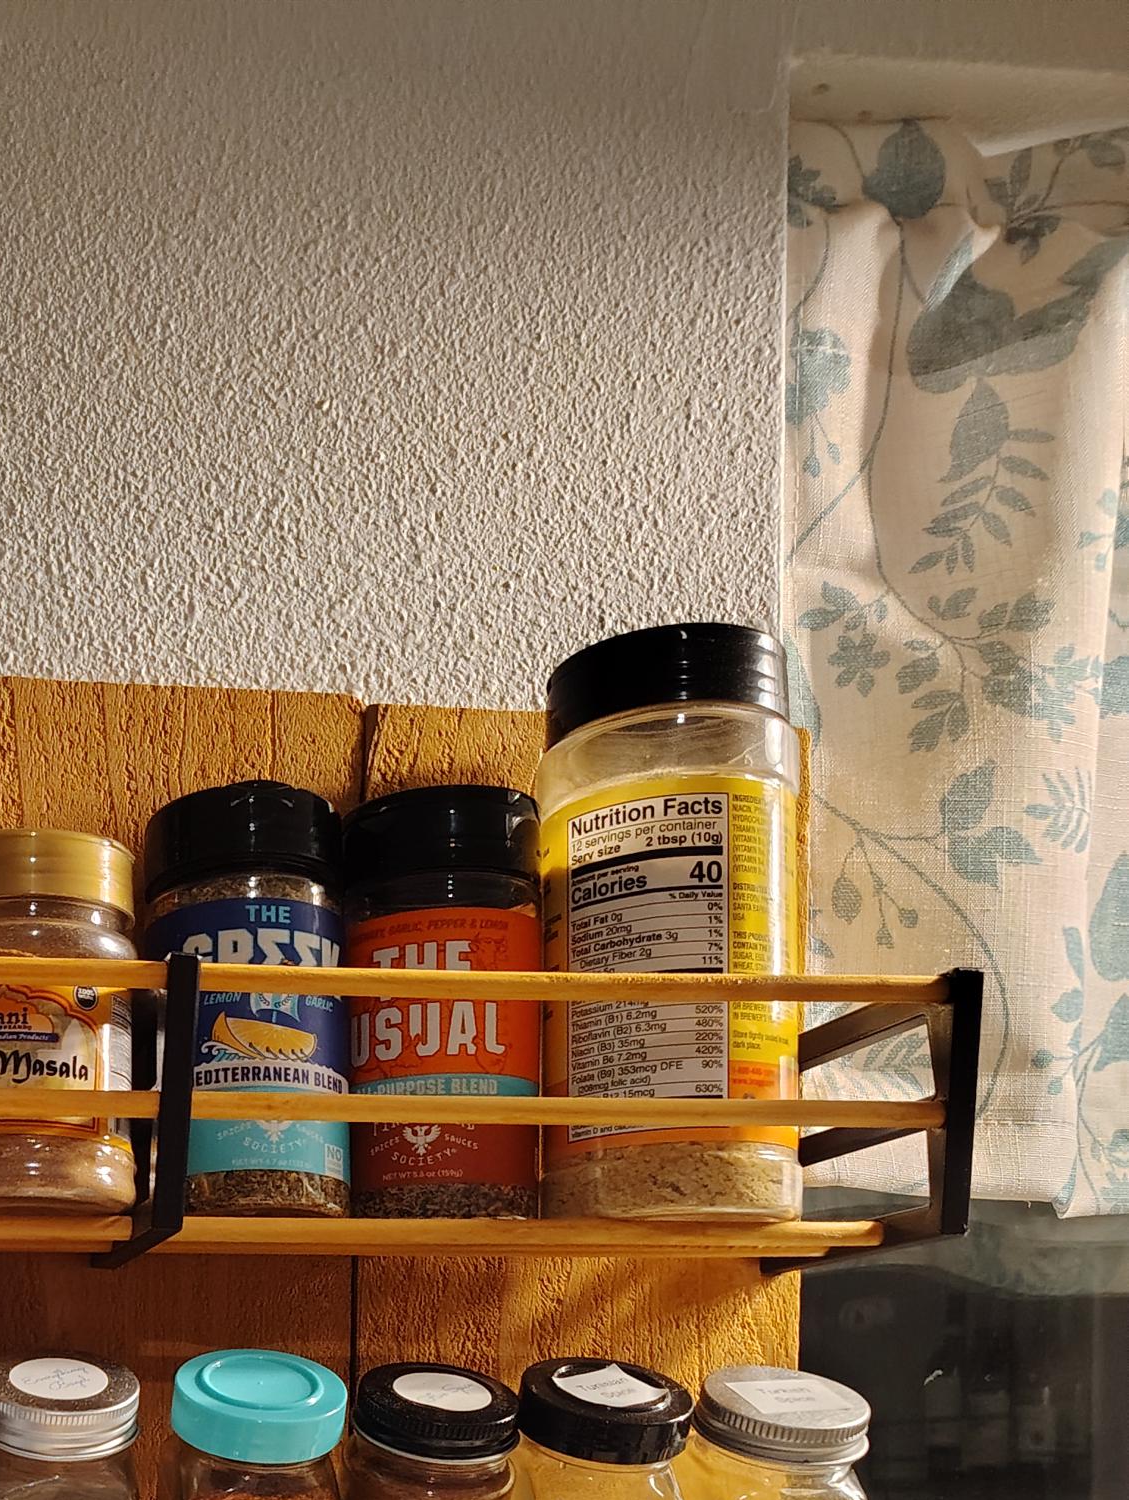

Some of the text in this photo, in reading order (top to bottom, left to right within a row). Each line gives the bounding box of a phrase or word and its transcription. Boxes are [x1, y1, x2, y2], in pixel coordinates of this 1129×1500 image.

[571, 798, 722, 839] Nutrition Facts
[585, 819, 717, 848] servings per container
[645, 831, 723, 847] 2 tbsp (10g)
[571, 844, 621, 866] Serv size
[689, 860, 722, 883] 40
[571, 873, 648, 905] Calories
[679, 891, 723, 900] Daily Value
[245, 904, 292, 924] THE
[707, 902, 723, 911] 0%
[594, 912, 623, 925] Fat 0g
[708, 916, 723, 925] 1%
[571, 924, 632, 945] Sodium 20mg
[708, 929, 723, 938] 1%
[593, 931, 678, 954] Carbohydrate 3g
[707, 942, 723, 951] 7%
[580, 948, 652, 970] Dietary 2g
[702, 956, 723, 965] 11%
[695, 1005, 723, 1014] 520%
[605, 1010, 657, 1025] (B1) 6.2mg
[695, 1019, 723, 1027] 480%
[351, 1001, 507, 1067] USUAL
[614, 1022, 667, 1037] (B2) 6.3mg
[695, 1032, 723, 1041] 220%
[597, 1038, 645, 1052] (B3) 35mg
[695, 1046, 723, 1054] 420%
[572, 1051, 647, 1071] Vitamin 7.2mg
[702, 1060, 723, 1069] 90%
[597, 1061, 683, 1080] (B9) 353mcg DFE
[193, 1065, 343, 1094] EDITERRANEAN BLEND
[451, 1078, 497, 1094] BLEND
[623, 1088, 655, 1099] 15mcg
[695, 1084, 723, 1093] 630%
[444, 1134, 478, 1150] SAUCES
[327, 1146, 342, 1161] NO
[391, 1148, 451, 1166] SOCIETY
